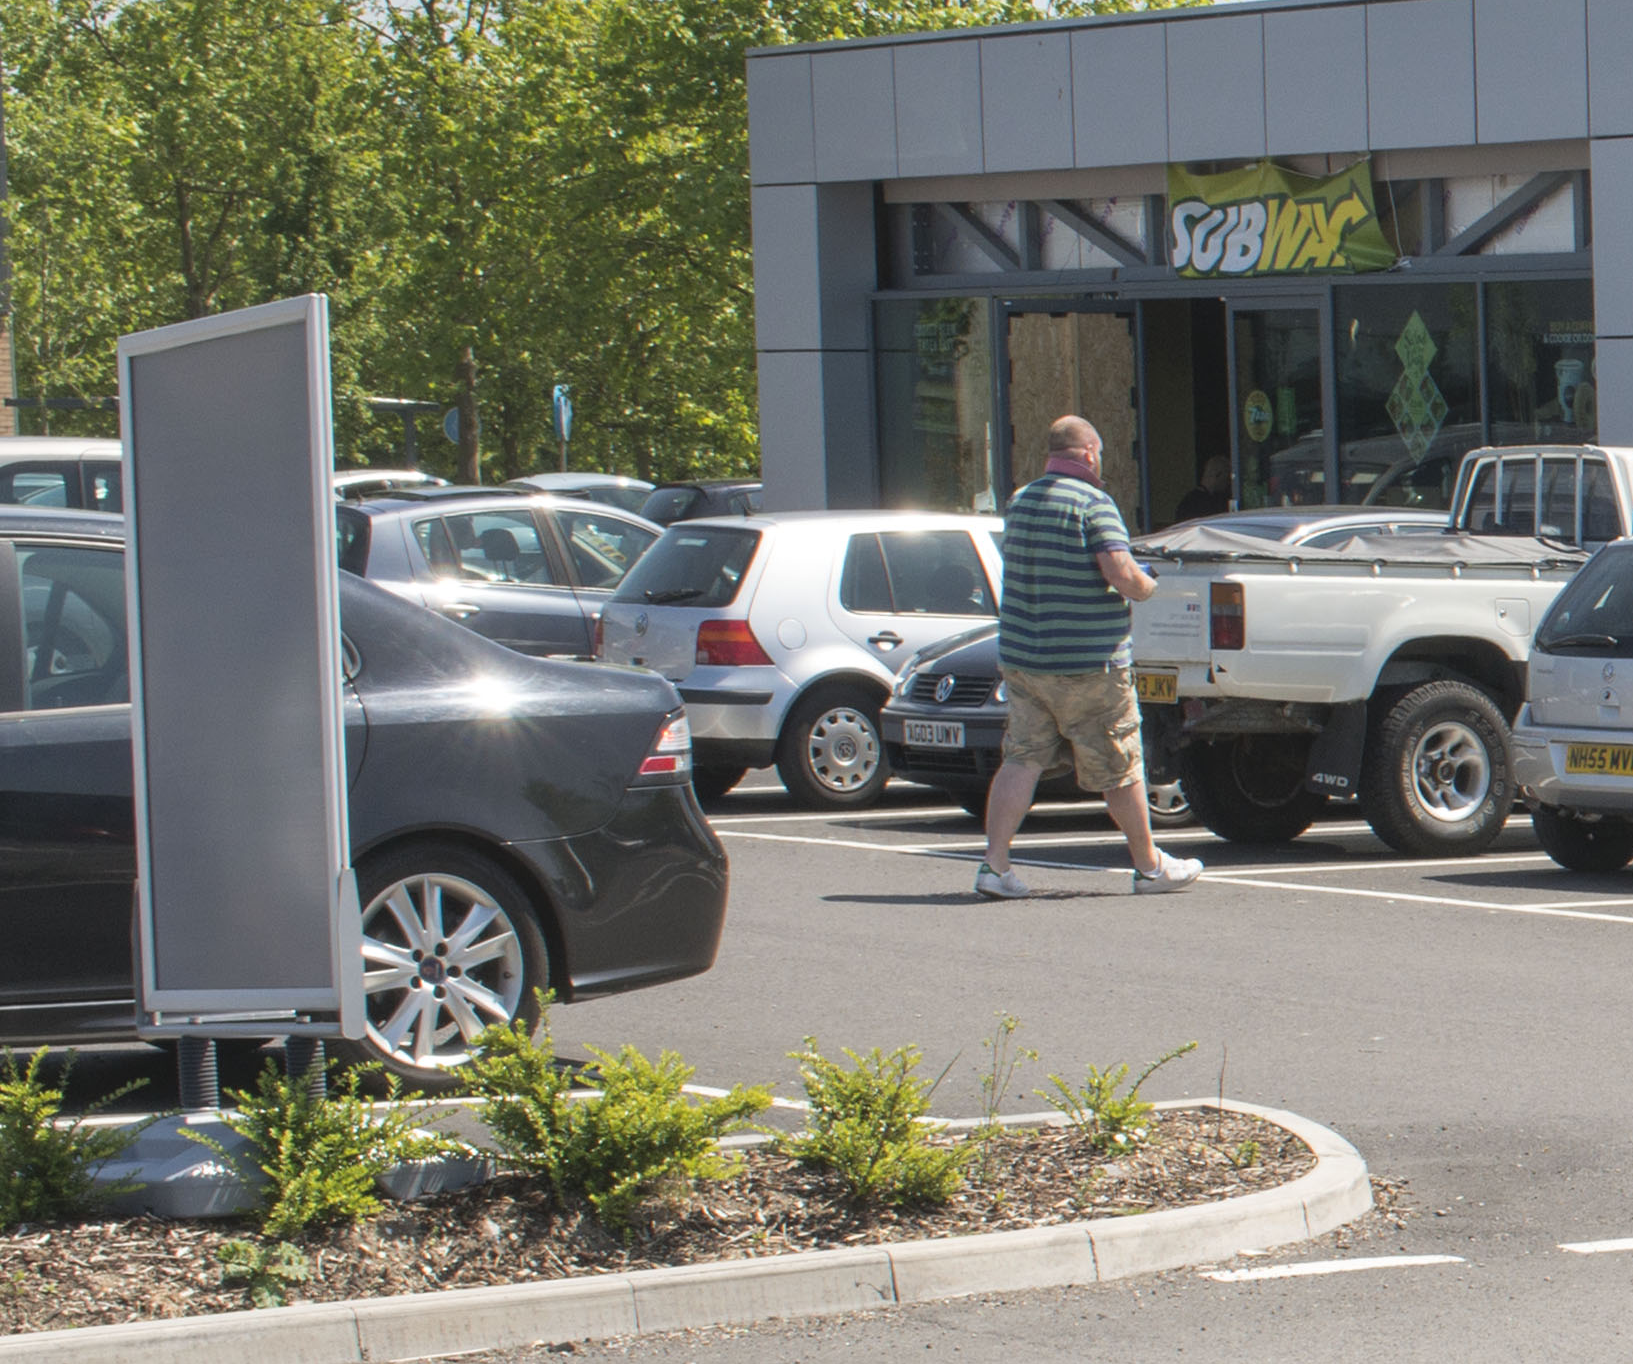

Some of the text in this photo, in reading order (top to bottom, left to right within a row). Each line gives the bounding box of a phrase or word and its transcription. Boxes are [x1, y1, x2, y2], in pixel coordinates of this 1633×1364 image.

[1171, 190, 1374, 274] SUBWAY
[1568, 747, 1607, 769] NH55
[1311, 772, 1349, 787] 4WD
